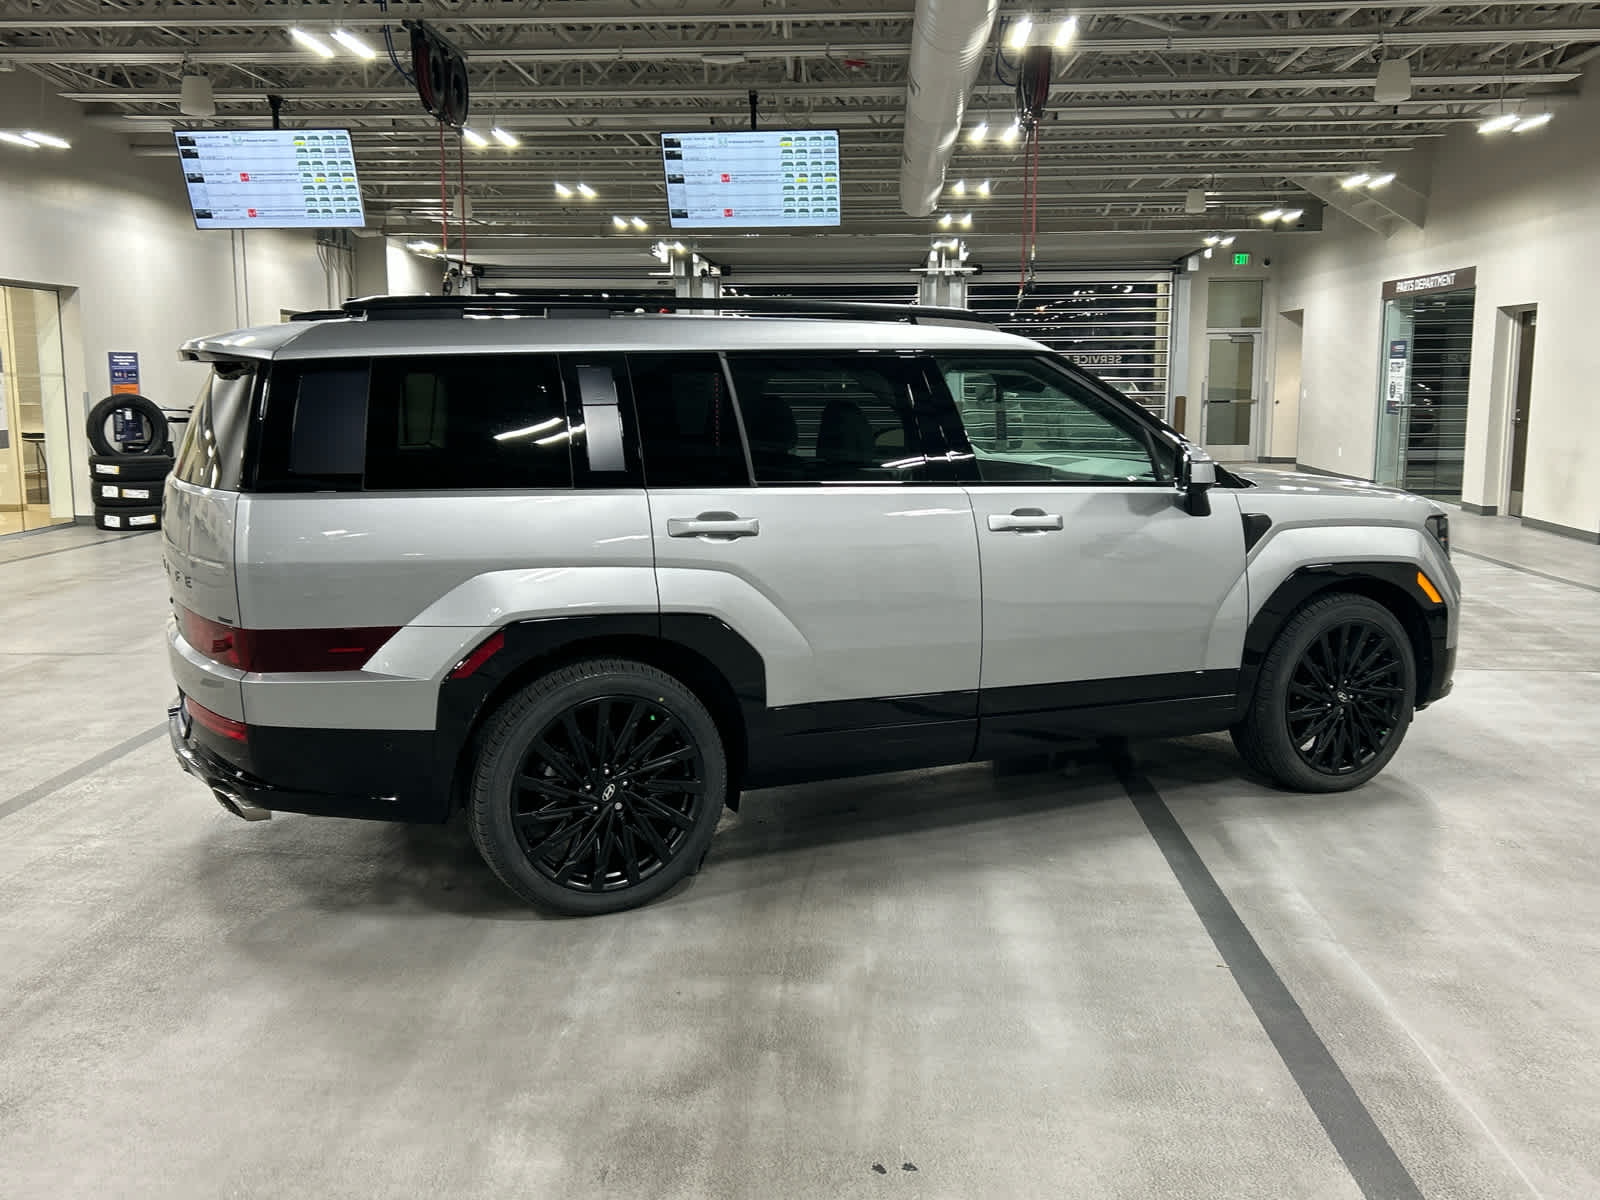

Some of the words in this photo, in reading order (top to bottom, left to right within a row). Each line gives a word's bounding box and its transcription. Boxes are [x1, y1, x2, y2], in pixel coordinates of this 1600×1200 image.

[1235, 254, 1249, 264] EXIT
[1396, 280, 1414, 292] PARTS
[1415, 273, 1455, 289] DEPARTMENT
